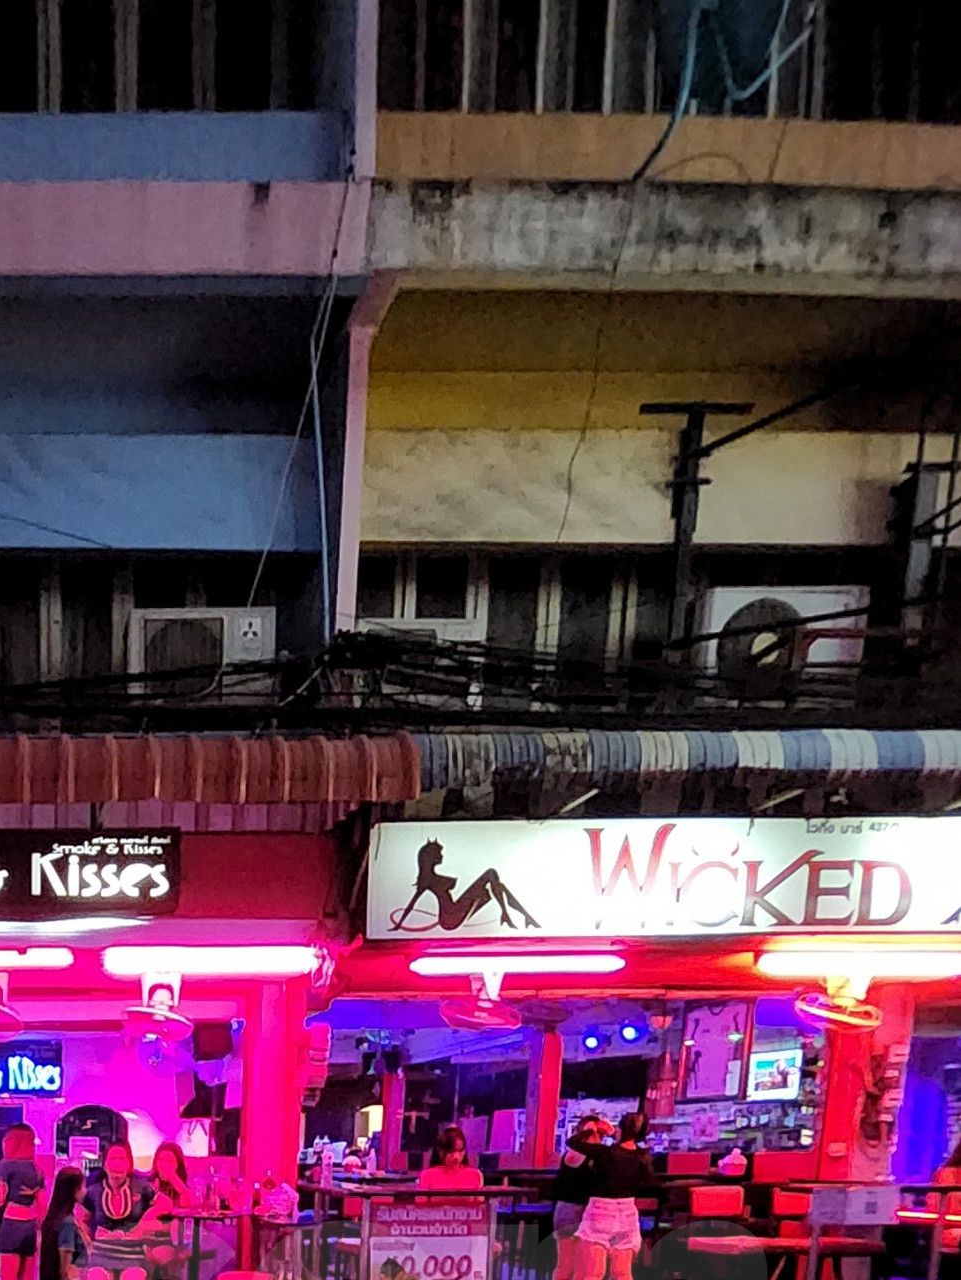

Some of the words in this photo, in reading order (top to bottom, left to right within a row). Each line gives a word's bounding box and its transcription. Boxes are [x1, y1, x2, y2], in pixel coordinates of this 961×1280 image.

[52, 841, 102, 856] Smoke
[105, 843, 120, 855] &
[123, 844, 164, 855] Kisses
[31, 852, 170, 898] Kisses
[583, 823, 912, 929] WICKED
